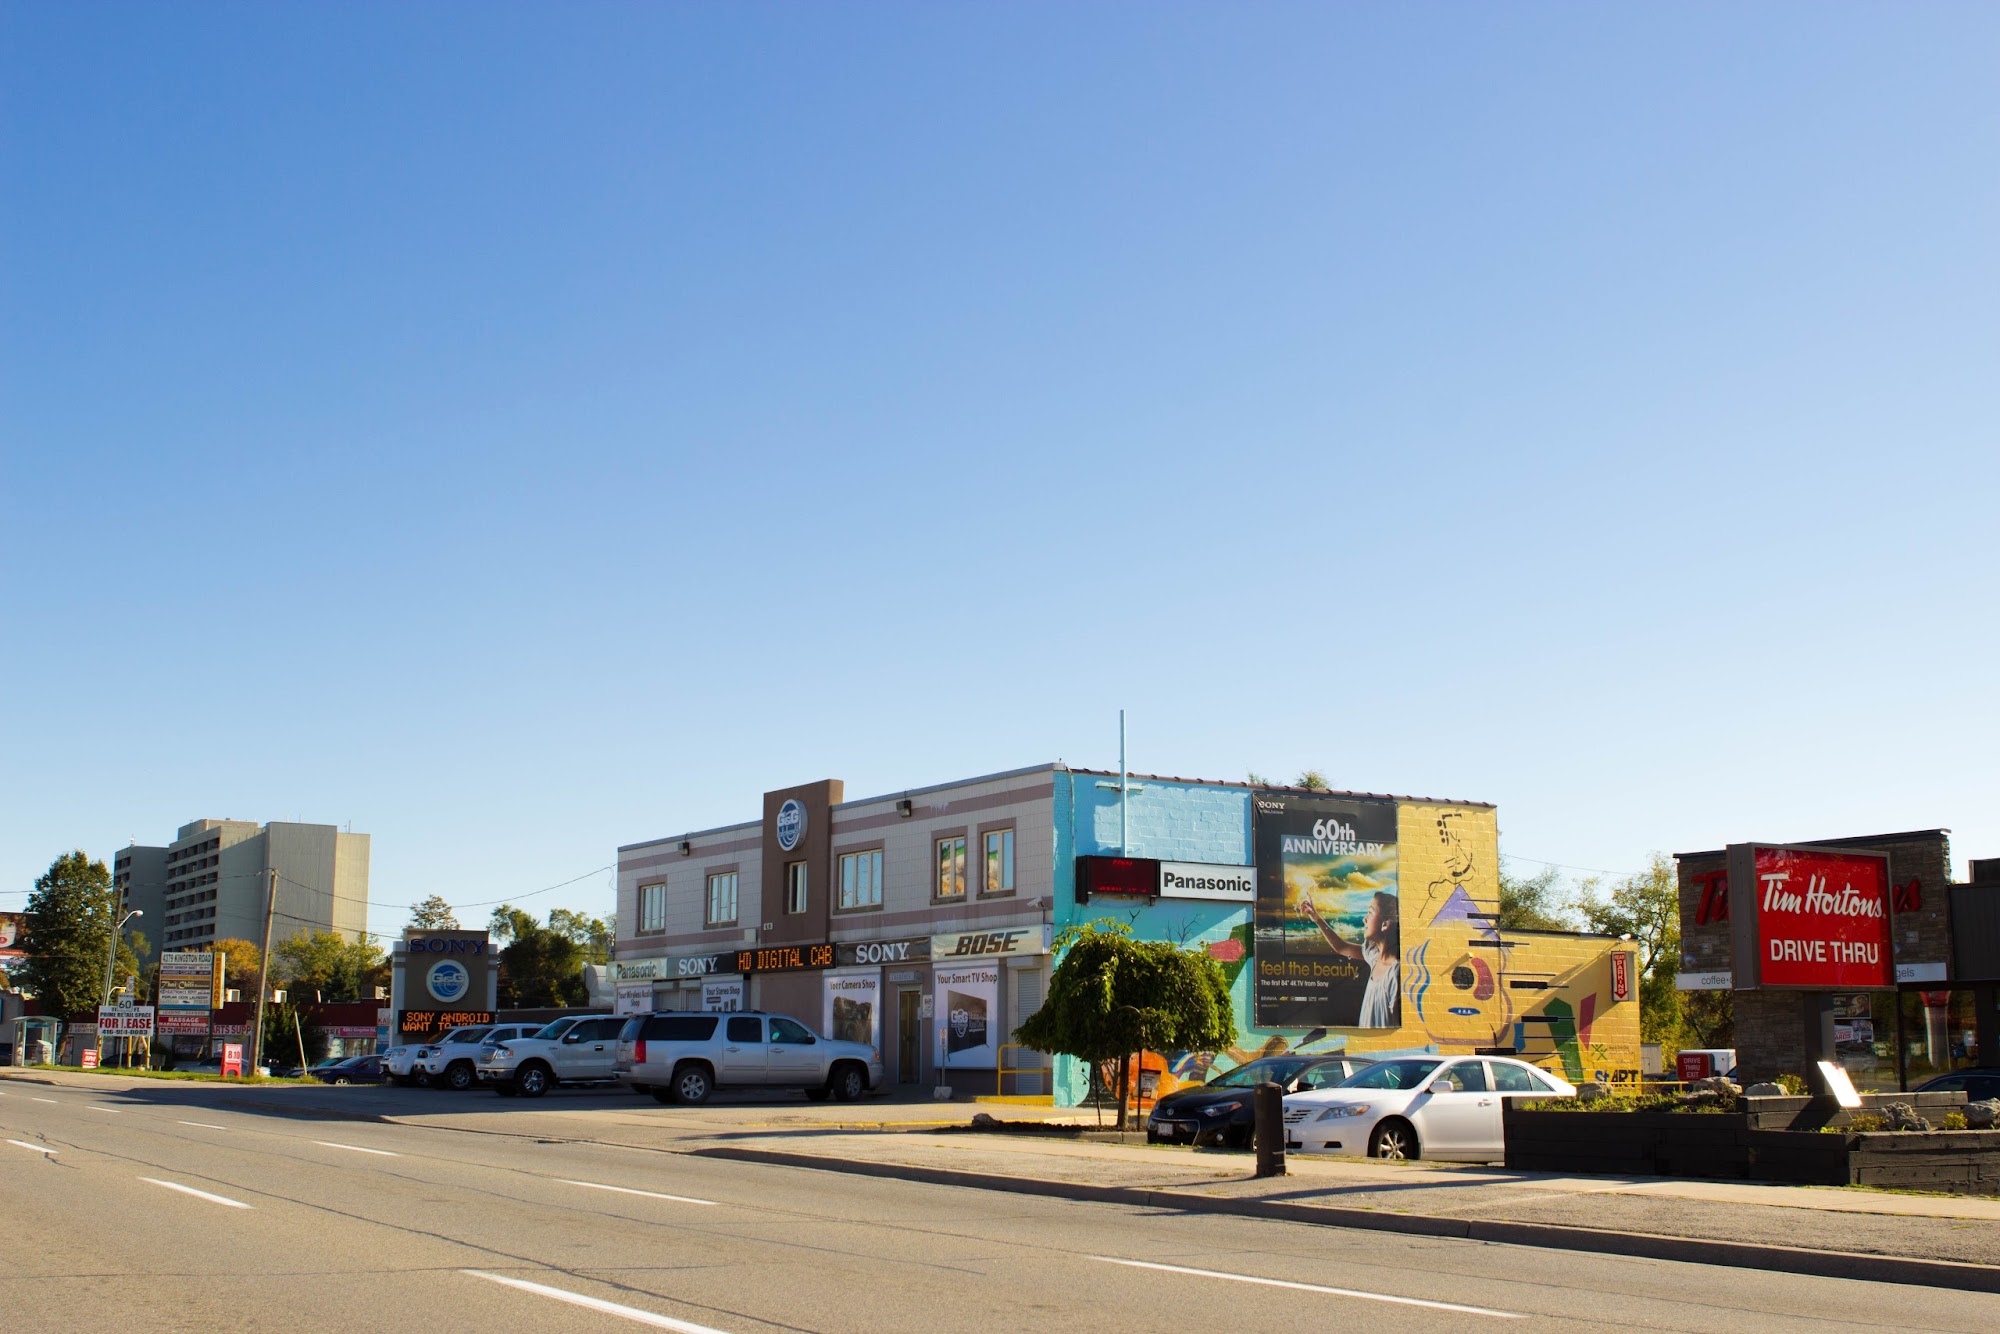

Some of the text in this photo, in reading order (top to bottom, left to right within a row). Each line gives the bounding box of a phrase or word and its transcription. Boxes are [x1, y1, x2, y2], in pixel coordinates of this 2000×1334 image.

[1313, 818, 1355, 841] 60th
[1283, 839, 1384, 857] ANNIVERSARY
[1163, 872, 1252, 892] Panasonic
[1760, 872, 1802, 914] Tim
[1804, 873, 1883, 918] Hortons
[409, 938, 488, 955] SONY
[945, 930, 1030, 956] BOSE
[174, 954, 198, 963] KINGSTON
[198, 955, 211, 963] ROAD
[738, 945, 833, 970] HD DIGITAL CAB
[855, 942, 910, 964] SONY
[1770, 939, 1879, 965] DRIVE THRU
[616, 961, 657, 979] Panasonic
[678, 957, 718, 975] SONY
[1261, 960, 1359, 980] feel the beauty
[829, 979, 876, 991] Your Camera Shop
[938, 972, 998, 984] Your Smart TV Shop
[1616, 960, 1625, 995] PARKING
[1701, 976, 1726, 985] coffee
[627, 990, 642, 999] Wireless
[706, 986, 741, 996] Your Stereo Shop
[118, 1000, 132, 1009] 60
[631, 998, 640, 1008] Shop
[99, 1018, 152, 1029] FOR LEASE
[406, 1012, 490, 1023] SONY ANDROID
[212, 1025, 230, 1034] ARTS
[402, 1022, 431, 1031] WANT
